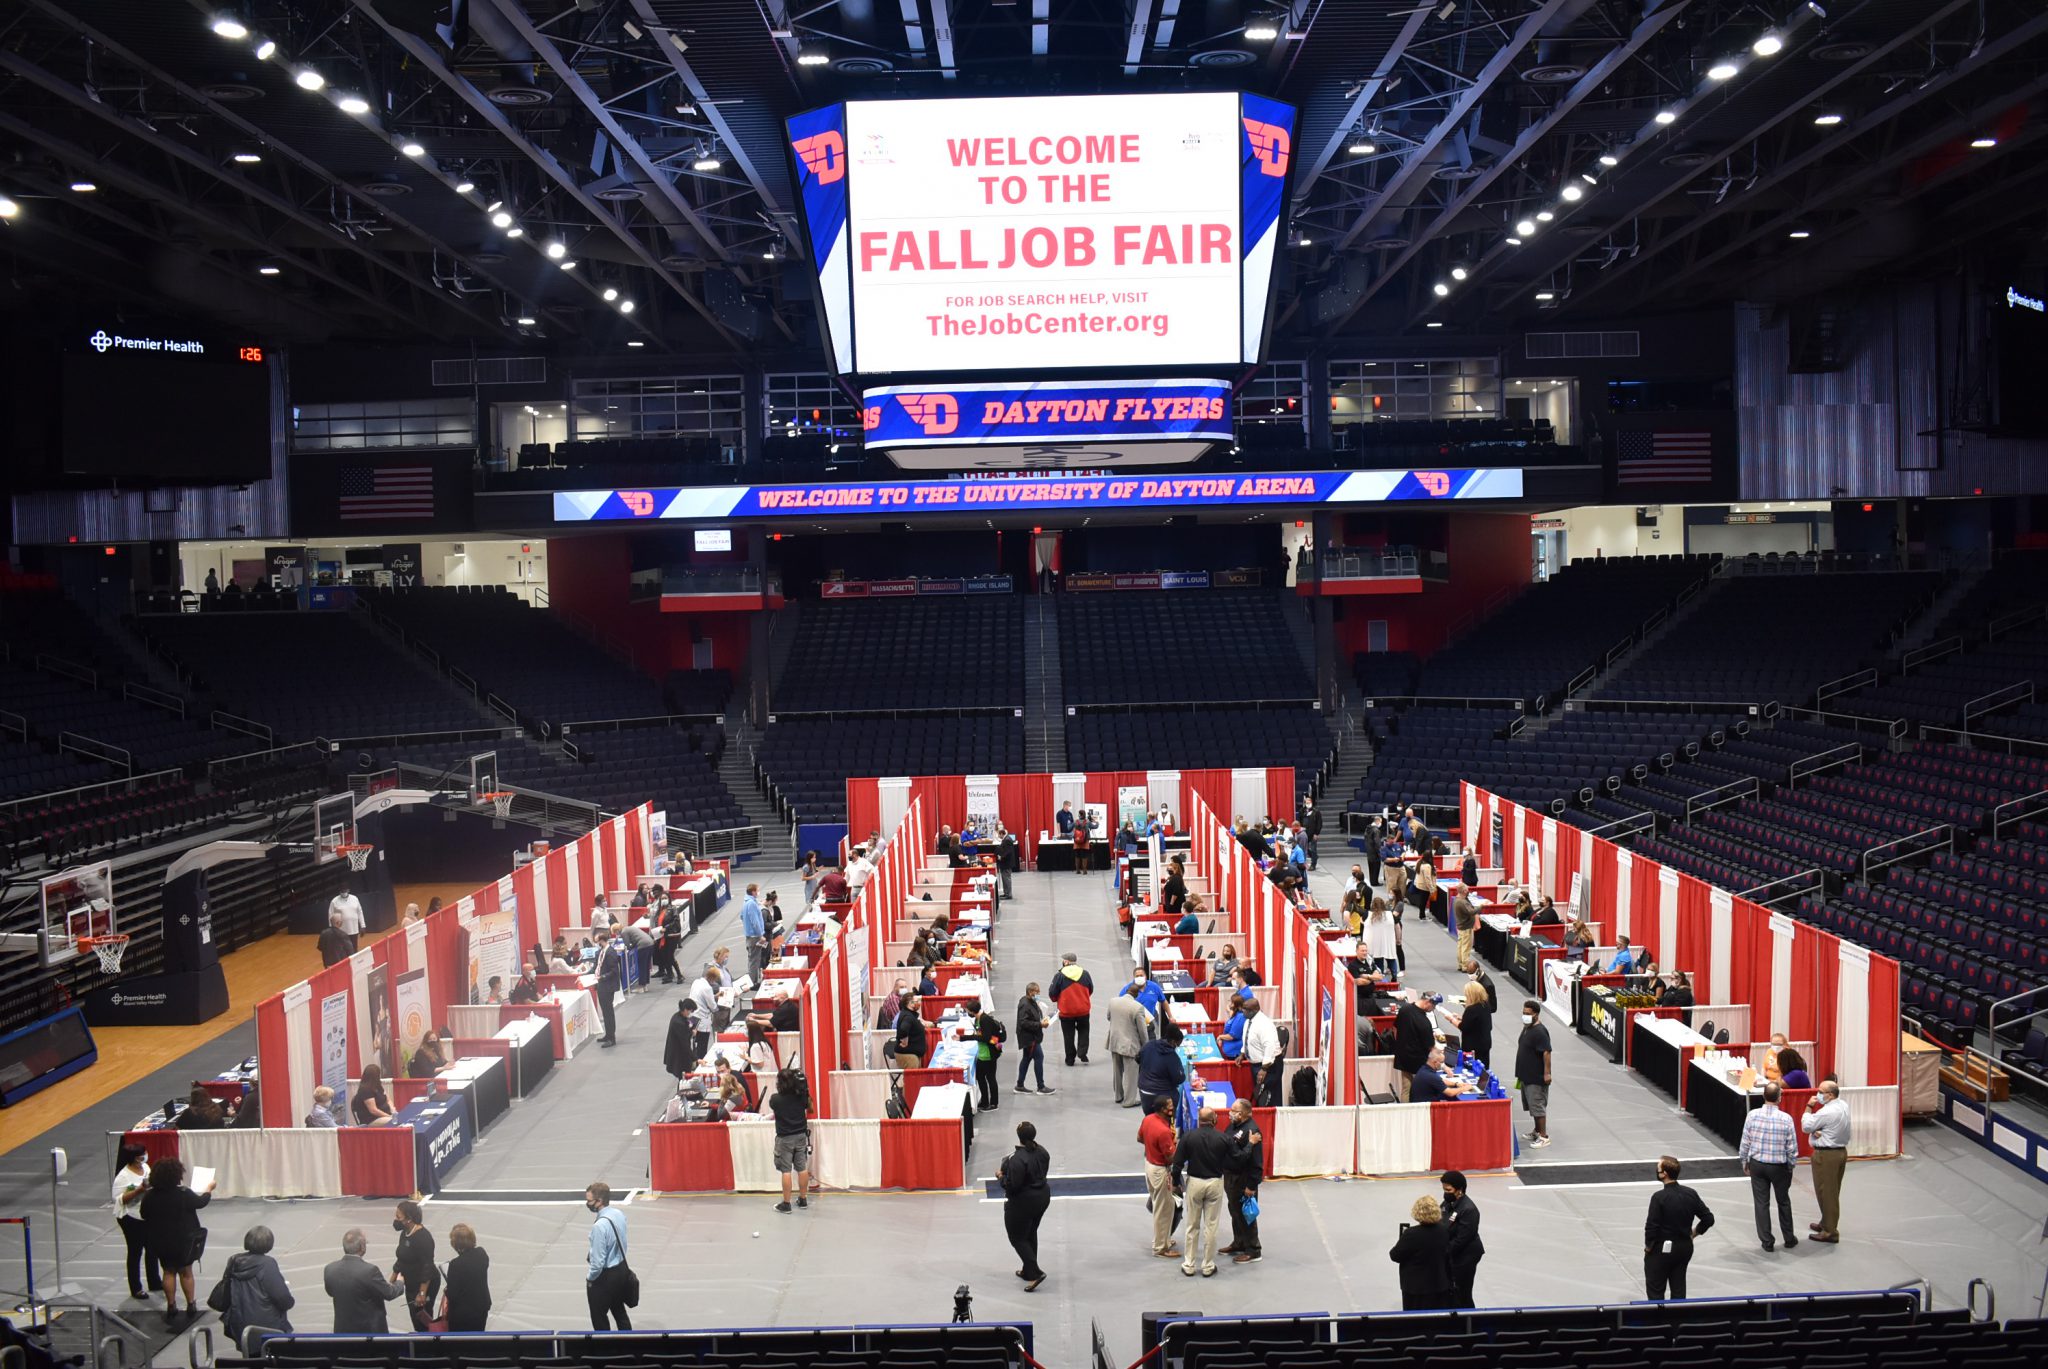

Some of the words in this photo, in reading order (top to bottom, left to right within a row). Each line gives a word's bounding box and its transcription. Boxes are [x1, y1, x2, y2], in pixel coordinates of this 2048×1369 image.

[947, 134, 1141, 167] WELCOME
[978, 176, 1028, 204] TO
[1037, 174, 1111, 203] THE
[860, 229, 989, 272] FALL
[998, 227, 1097, 269] JOB
[1113, 223, 1232, 265] FAIR
[946, 295, 974, 307] FOR
[978, 294, 1005, 307] JOB
[1007, 293, 1066, 306] SEARCH
[1068, 293, 1109, 306] HELP,
[1112, 292, 1149, 304] VISIT
[926, 312, 1169, 337] TheJobCenter.org
[114, 335, 162, 350] Premier
[164, 339, 204, 353] Health
[240, 348, 262, 361] 1:26
[981, 399, 1111, 425] DAYTON
[1113, 397, 1225, 421] FLYERS
[758, 488, 873, 508] WELCOME
[878, 487, 910, 505] TO
[913, 485, 959, 504] THE
[963, 482, 1101, 502] UNIVERSITY
[1108, 481, 1139, 499] OF
[1142, 479, 1235, 498] DAYTON
[1237, 477, 1316, 497] ARENA
[273, 556, 297, 568] Kroger
[391, 559, 415, 572] Kroger
[872, 584, 915, 592] MASSACHUSETTS
[1229, 575, 1247, 583] VCU
[147, 993, 167, 1001] Health
[1591, 1000, 1616, 1037] AMPM
